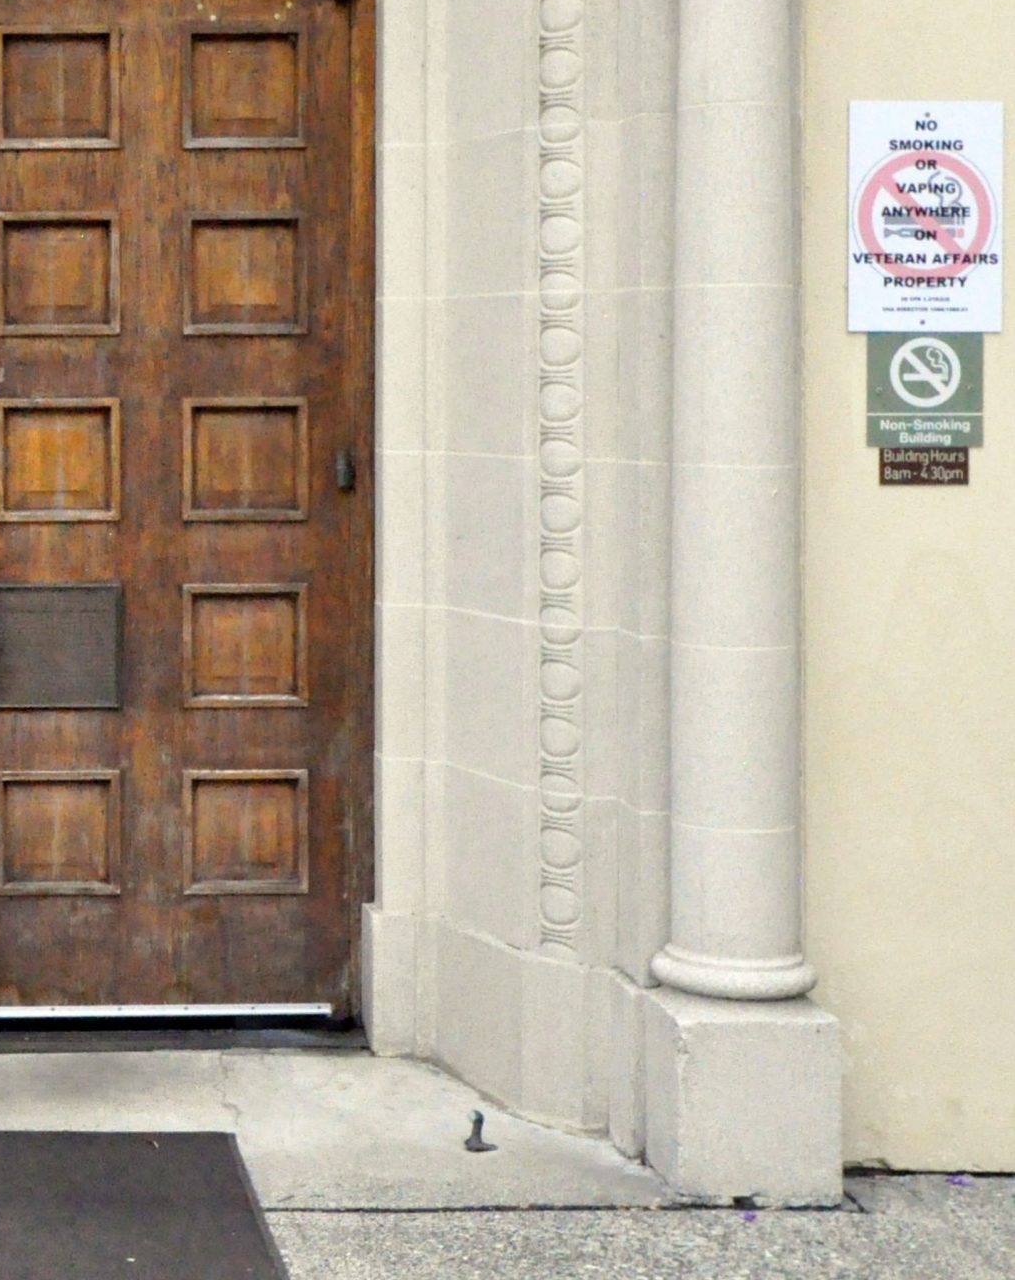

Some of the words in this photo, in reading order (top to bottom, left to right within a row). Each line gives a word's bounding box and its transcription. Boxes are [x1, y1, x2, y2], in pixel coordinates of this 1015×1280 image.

[915, 120, 938, 131] NO
[889, 139, 964, 151] SMOKING
[915, 159, 938, 170] OR
[896, 183, 956, 194] VAPING
[882, 206, 970, 217] ANYWHERE
[914, 229, 937, 240] ON
[853, 253, 927, 264] VETERAN
[932, 253, 998, 264] AFFAIRS
[883, 276, 968, 288] PROPERTY
[880, 419, 971, 433] Non-Smoking
[899, 432, 952, 446] Building
[884, 449, 929, 466] Building
[930, 450, 965, 462] Hours
[884, 467, 911, 480] 8am
